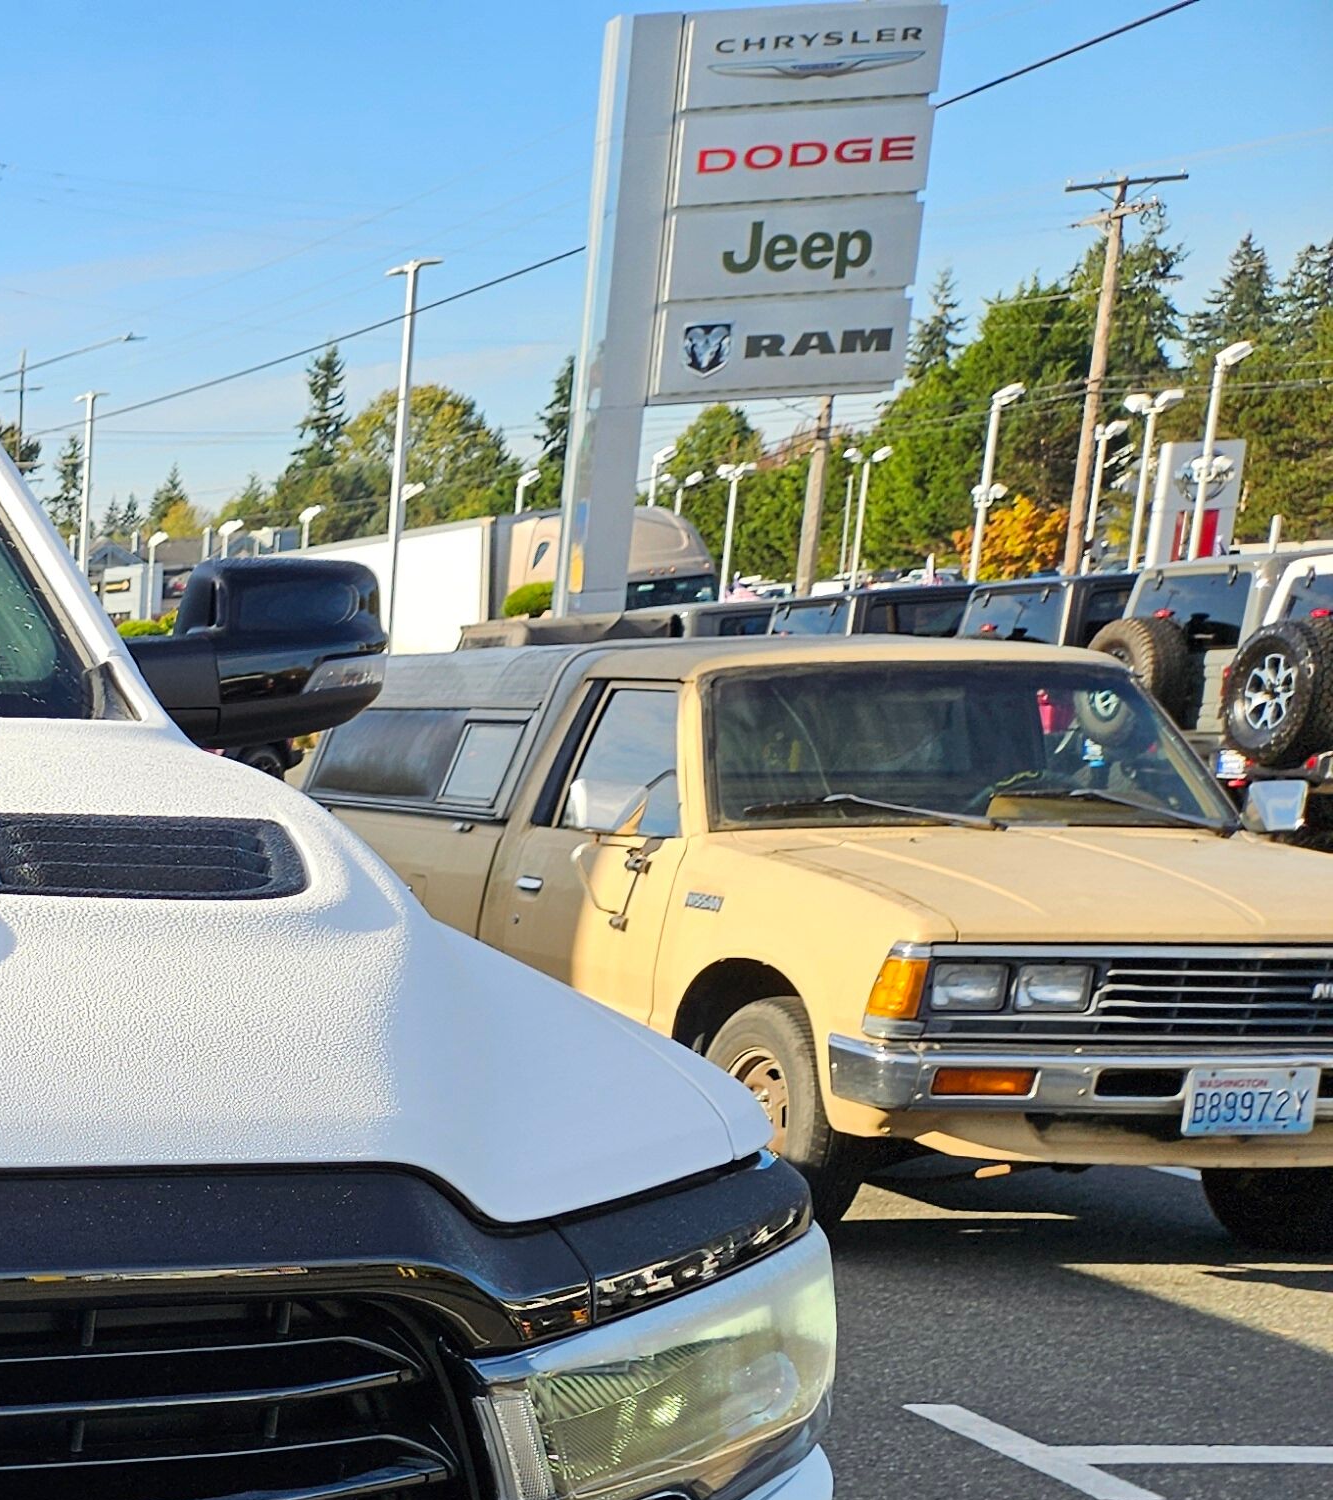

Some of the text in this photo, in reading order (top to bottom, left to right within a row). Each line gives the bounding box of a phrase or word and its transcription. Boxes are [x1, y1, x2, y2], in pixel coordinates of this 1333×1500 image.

[715, 26, 923, 54] CHRYSLER
[696, 136, 917, 175] DODGE
[722, 221, 873, 280] Jeep
[744, 327, 893, 359] RAM
[1192, 1088, 1309, 1124] B89972Y
